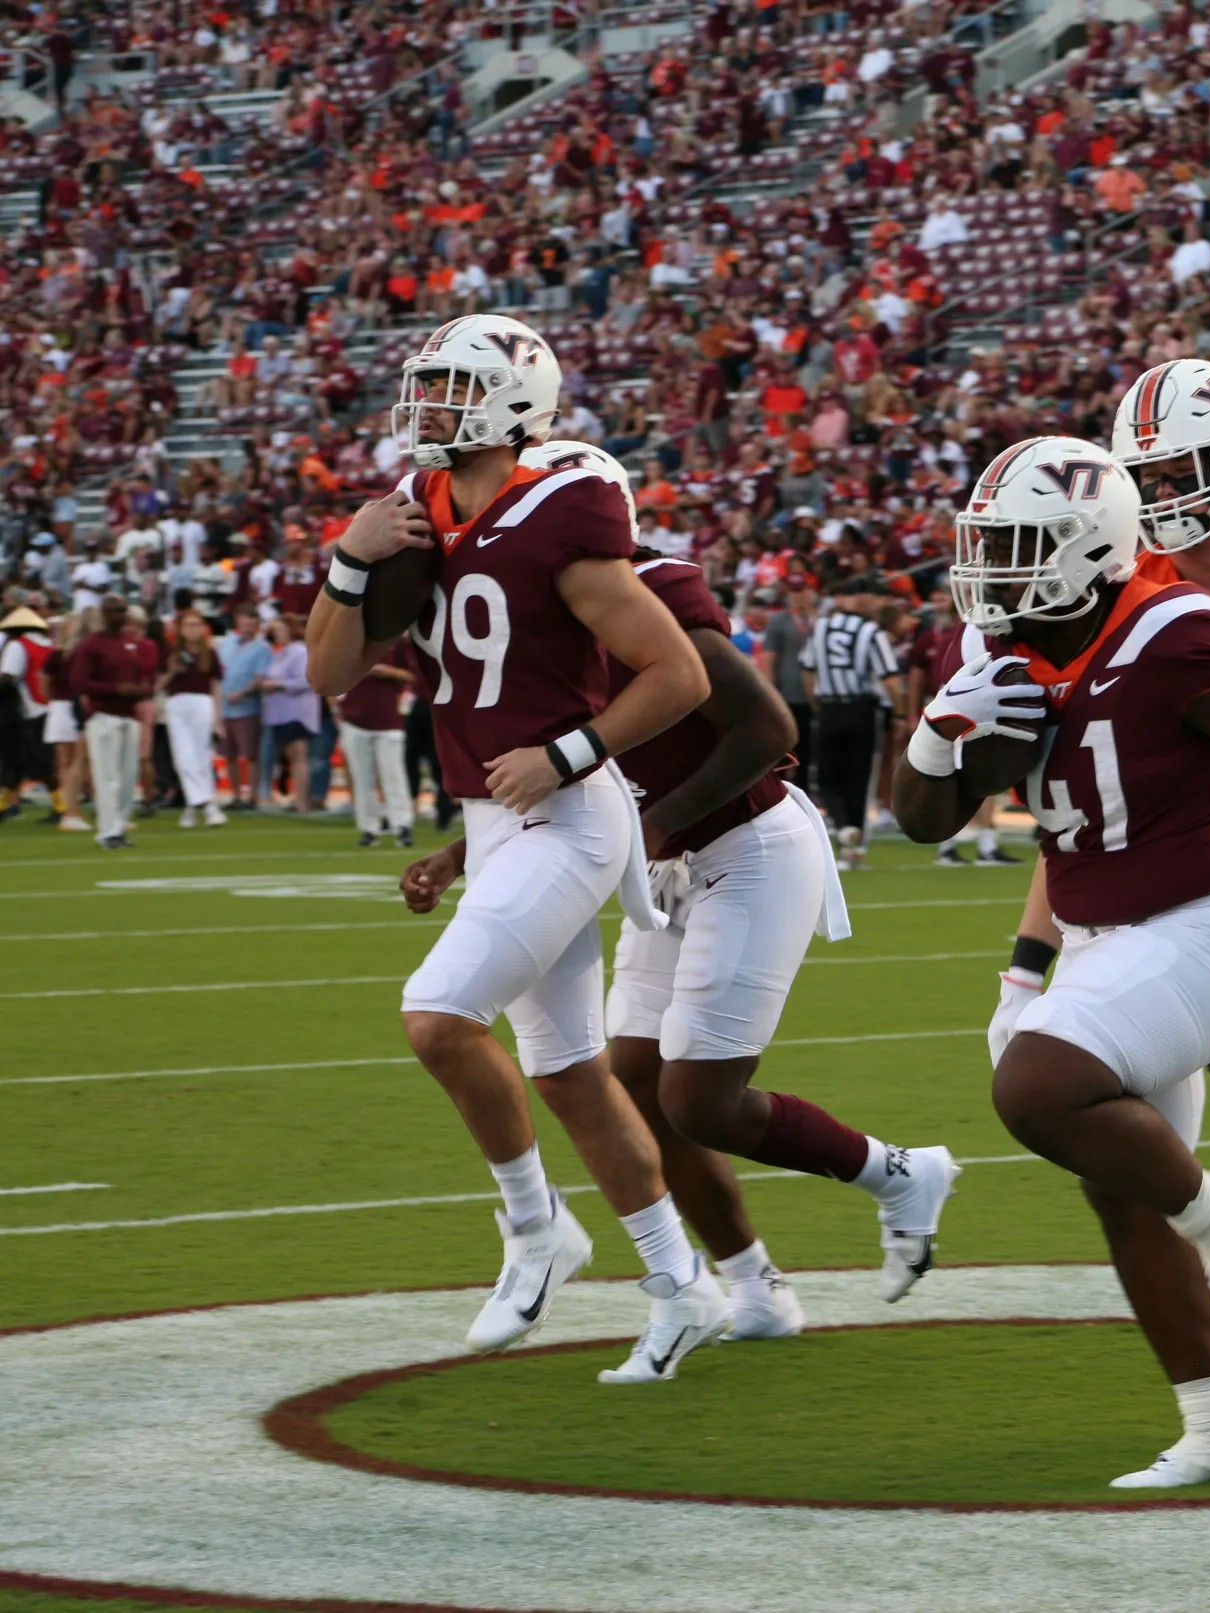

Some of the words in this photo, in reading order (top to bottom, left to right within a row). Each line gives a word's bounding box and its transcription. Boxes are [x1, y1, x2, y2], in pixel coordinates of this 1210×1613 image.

[1036, 460, 1113, 502] VT
[443, 532, 461, 545] VT
[1026, 719, 1128, 852] 41
